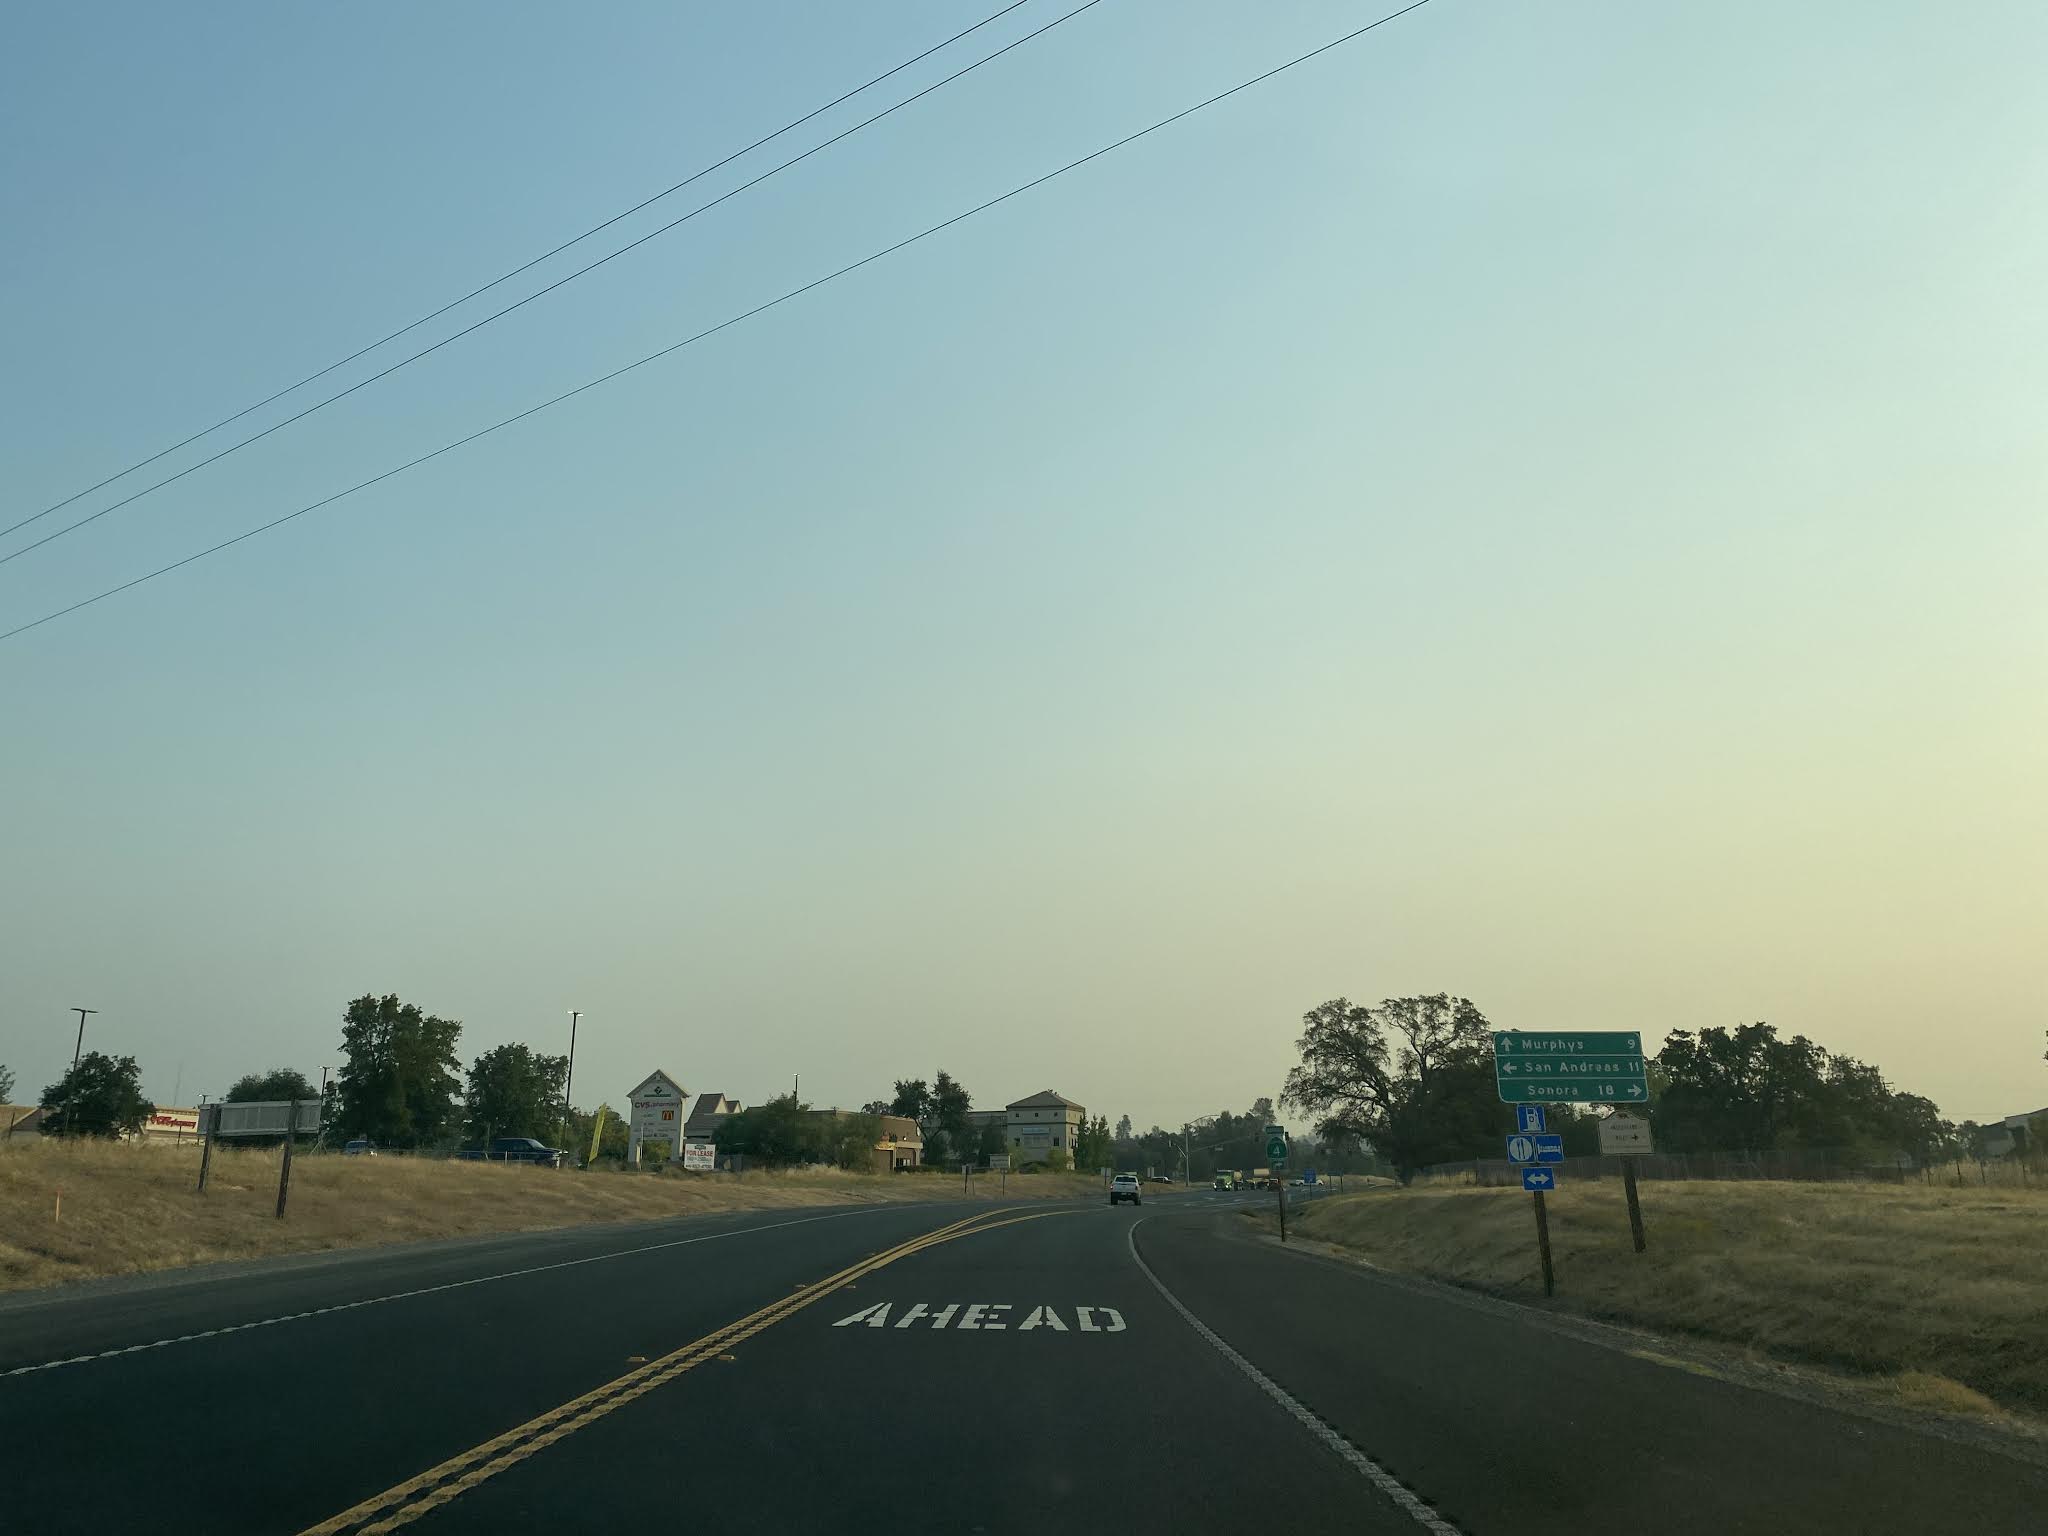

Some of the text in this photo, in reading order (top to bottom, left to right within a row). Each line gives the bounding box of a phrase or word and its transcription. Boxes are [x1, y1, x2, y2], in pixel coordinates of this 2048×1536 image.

[1522, 1039, 1636, 1052] Murphys 9
[1525, 1062, 1640, 1073] San Andreas 11
[1528, 1085, 1614, 1096] Sonora 18
[1273, 1145, 1280, 1156] 4
[832, 1302, 1127, 1332] AHEAD
